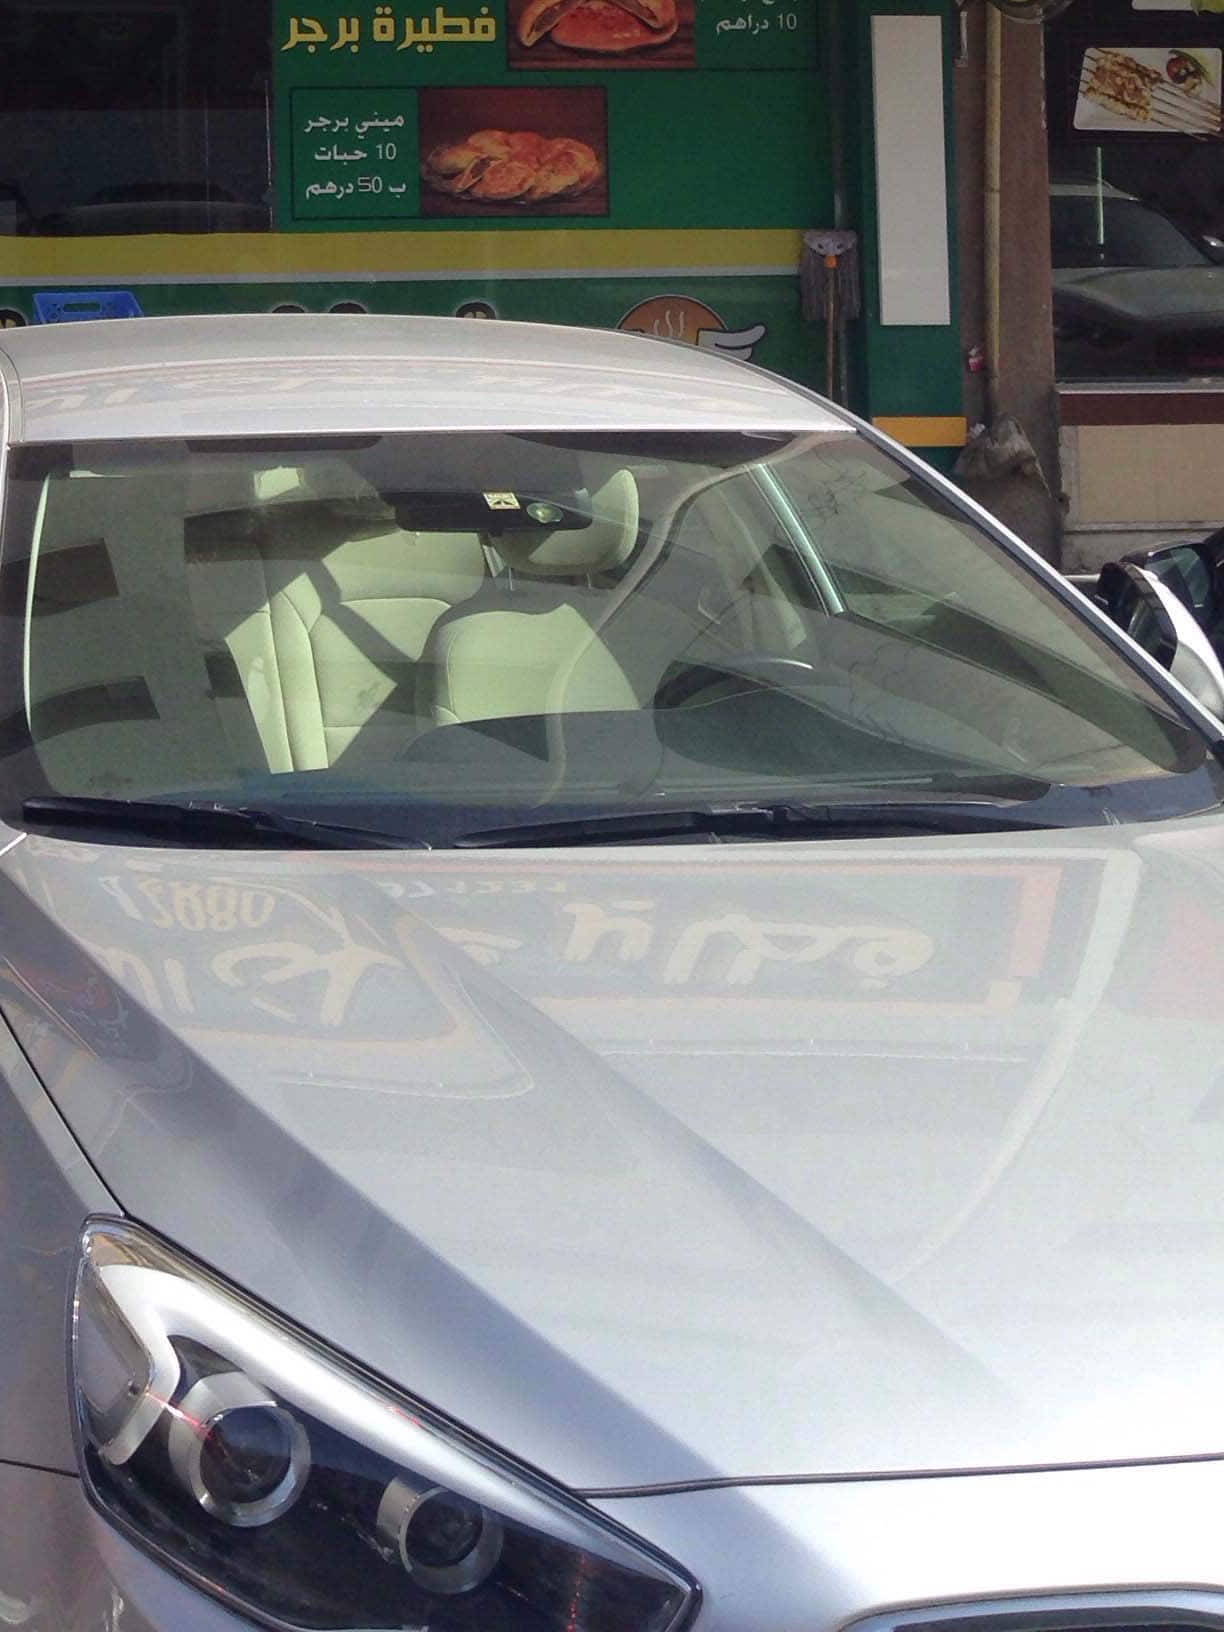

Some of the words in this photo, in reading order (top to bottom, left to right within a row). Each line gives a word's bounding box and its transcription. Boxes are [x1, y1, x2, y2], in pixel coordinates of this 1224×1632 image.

[373, 5, 497, 54] فطيرة
[716, 13, 769, 36] دراهم
[778, 13, 798, 30] 10
[280, 17, 359, 54] برجر
[303, 117, 350, 133] برجر
[355, 111, 405, 140] ميني
[314, 144, 368, 166] حبات
[376, 142, 397, 160] 10
[306, 181, 355, 200] درهم
[357, 175, 384, 194] 50
